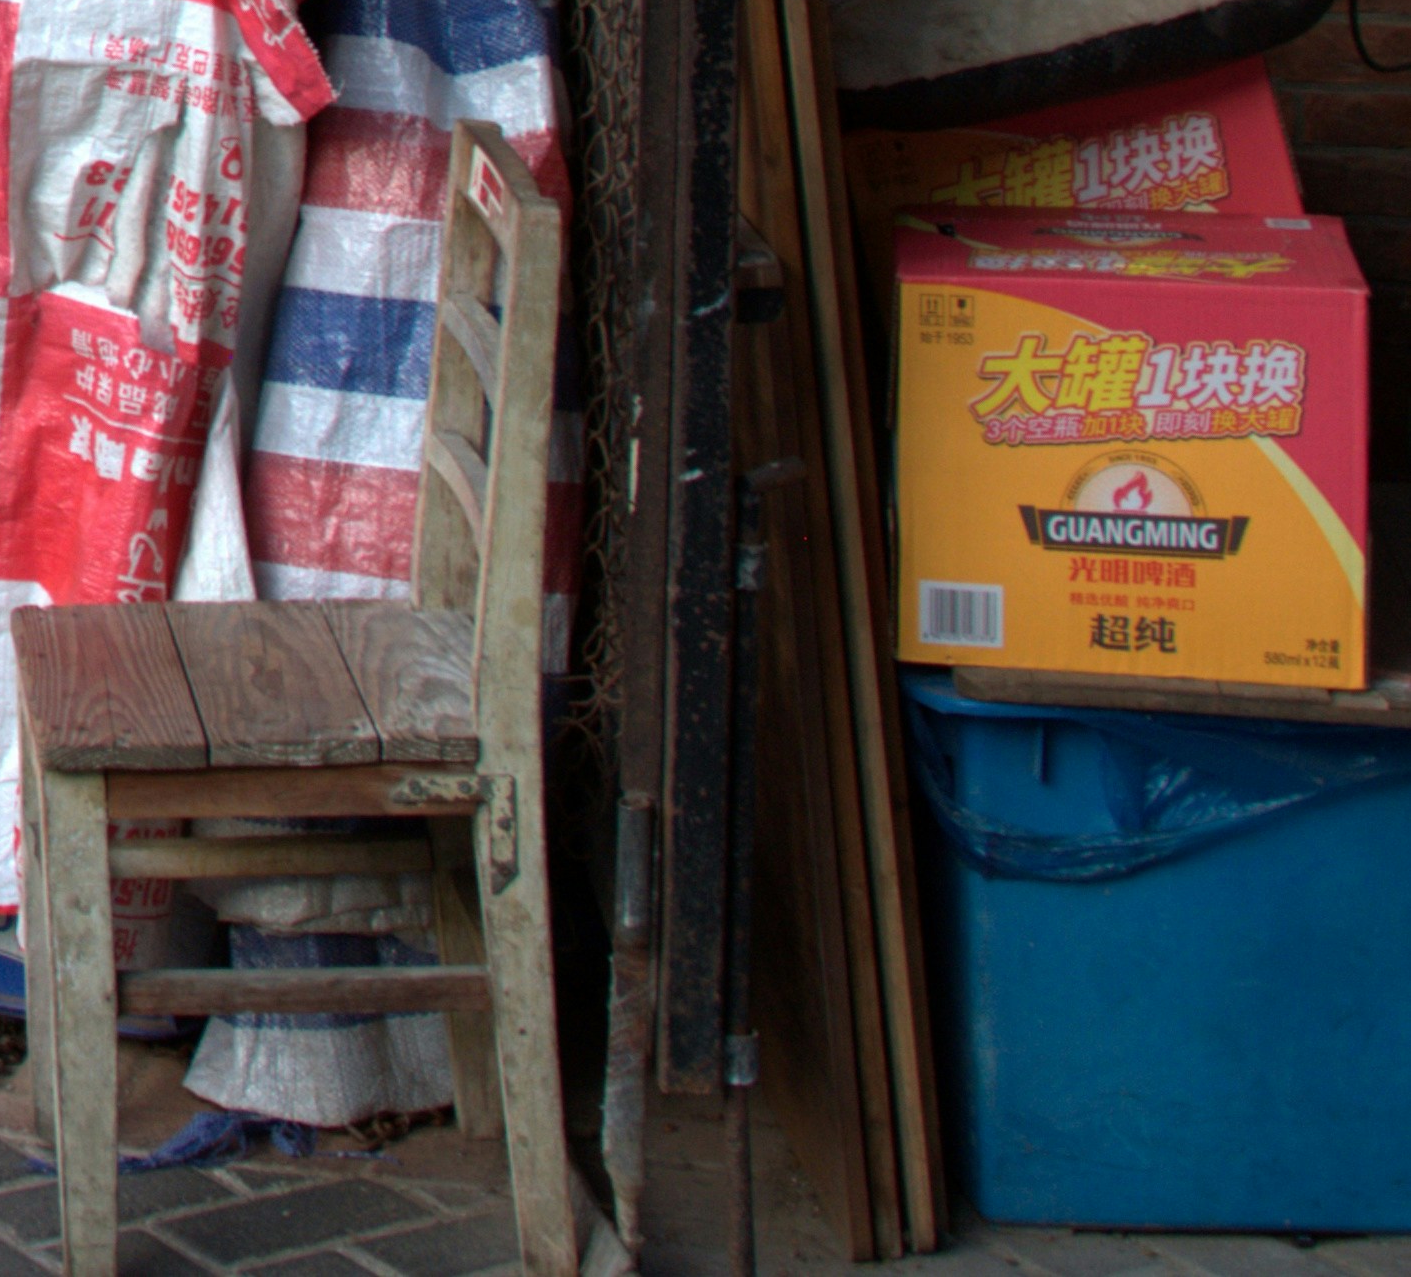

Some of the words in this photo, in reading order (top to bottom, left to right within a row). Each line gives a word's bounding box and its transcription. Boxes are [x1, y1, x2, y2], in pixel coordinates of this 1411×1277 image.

[932, 114, 1222, 208] 大罐1块换
[976, 334, 1300, 416] 大罐1块换
[1155, 407, 1296, 434] 即刻换大罐
[1046, 514, 1219, 550] GUANGMING
[1068, 556, 1197, 588] 光明啤酒
[1089, 613, 1177, 653] 超纯
